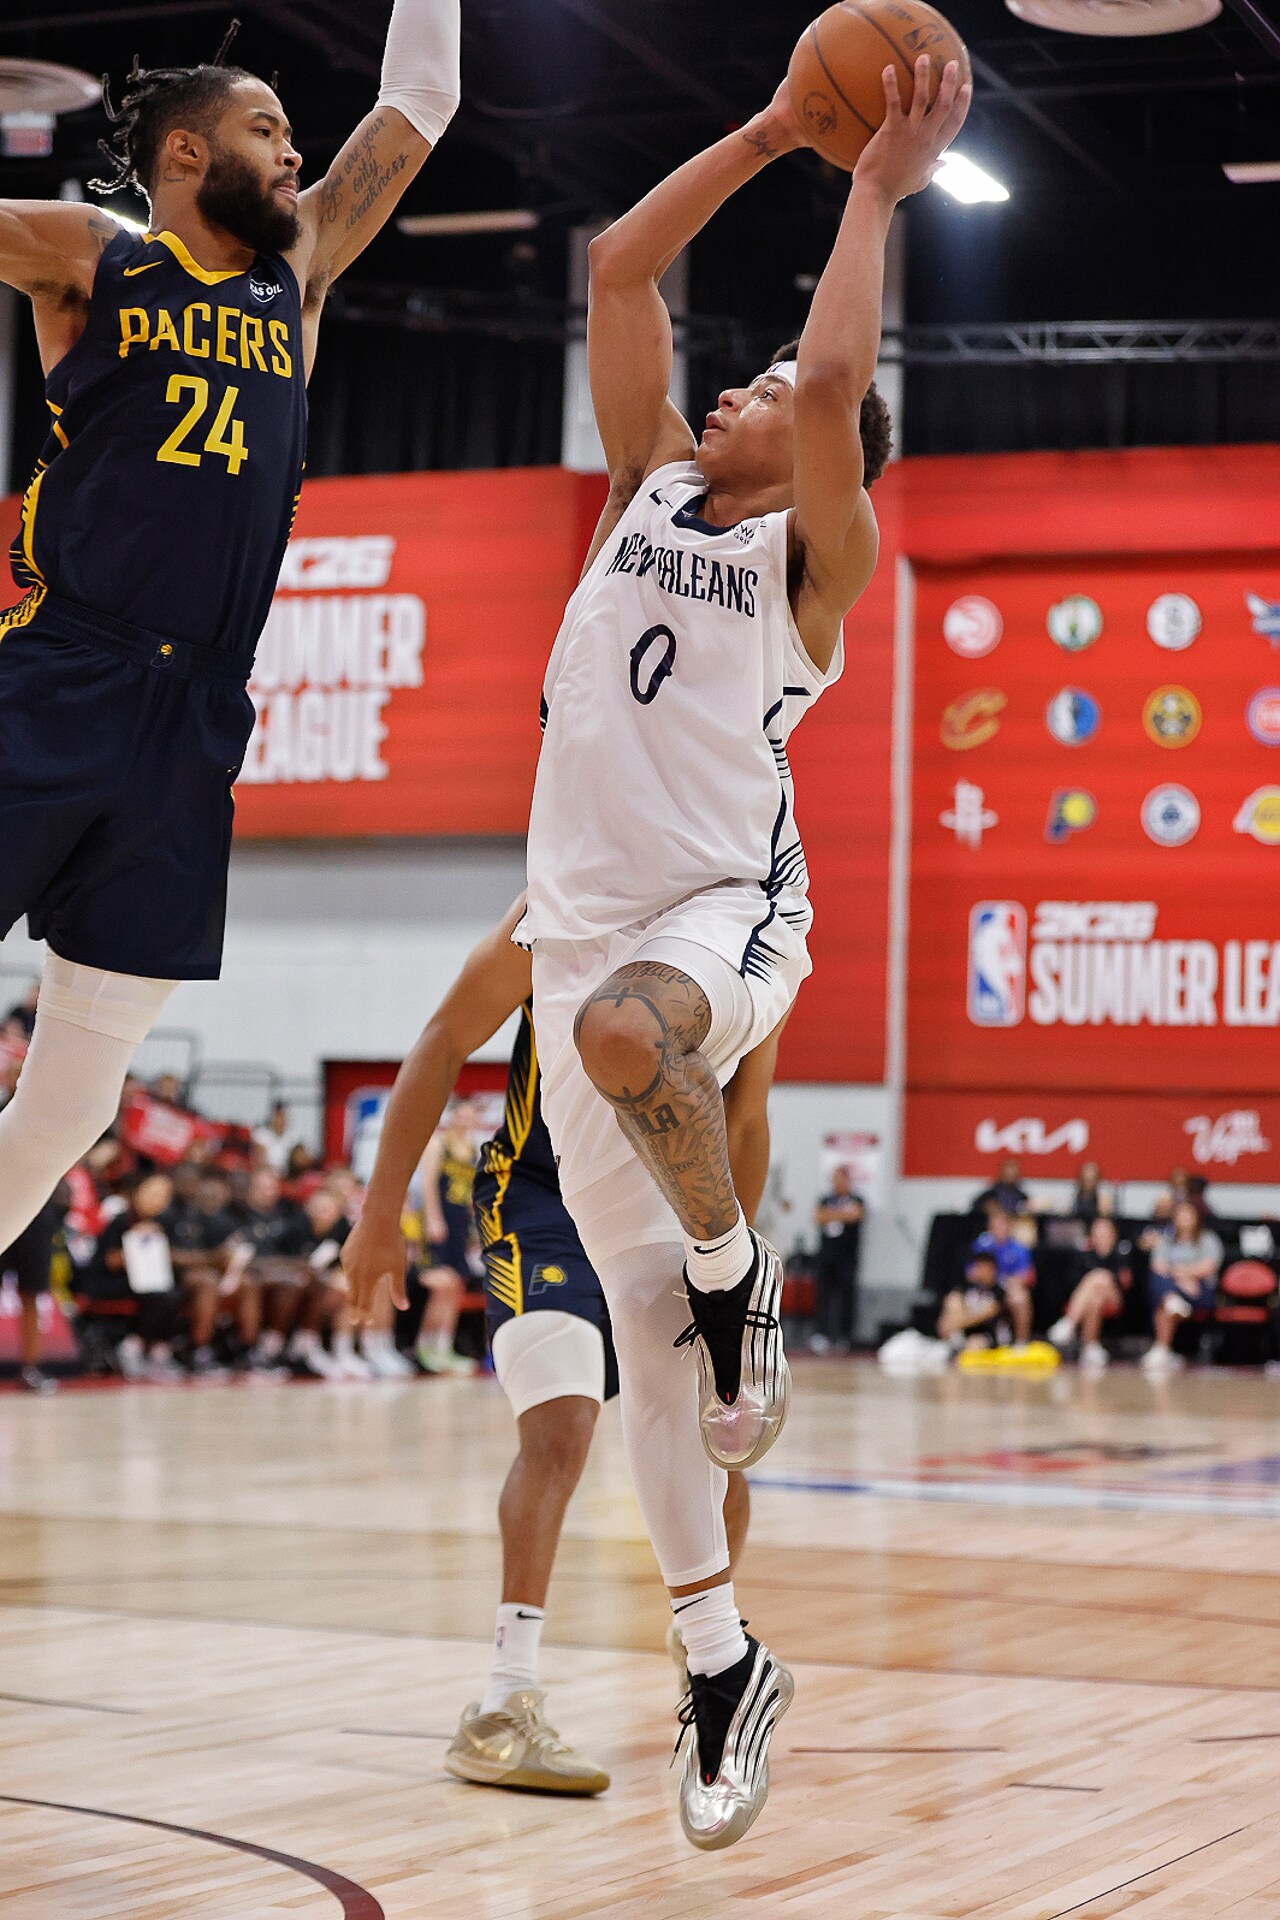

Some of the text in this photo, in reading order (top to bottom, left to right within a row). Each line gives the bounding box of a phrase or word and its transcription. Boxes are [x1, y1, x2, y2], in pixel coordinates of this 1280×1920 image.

[265, 283, 284, 296] OIL
[118, 302, 292, 379] PACERS
[156, 373, 249, 475] 24
[247, 594, 426, 690] UMMER
[630, 623, 677, 705] 0
[234, 688, 390, 784] EAGUE
[1029, 940, 1219, 1026] SUMMER
